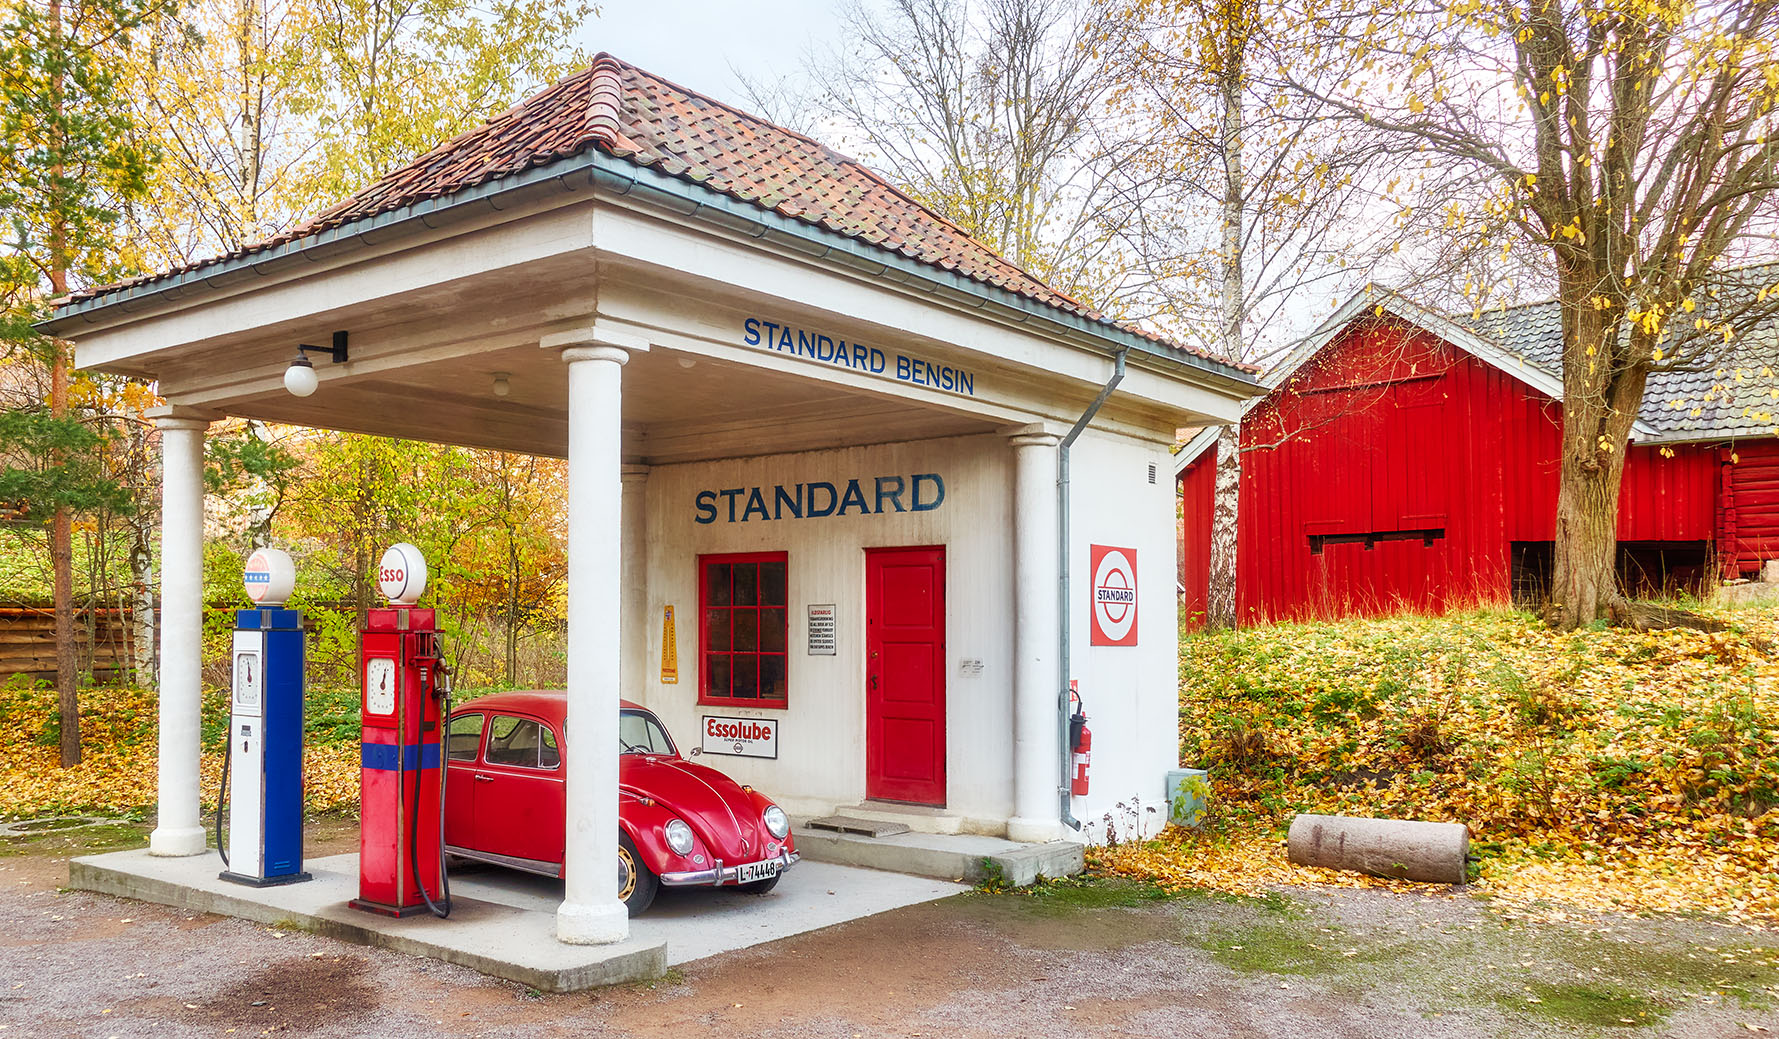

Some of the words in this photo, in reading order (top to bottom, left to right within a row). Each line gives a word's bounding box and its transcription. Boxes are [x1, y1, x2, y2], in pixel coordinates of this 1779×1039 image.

[743, 318, 886, 374] STANDARD
[896, 355, 974, 395] BENSIN
[694, 473, 946, 525] STANDARD
[1097, 589, 1134, 602] STANDARD
[707, 718, 772, 741] Essolube
